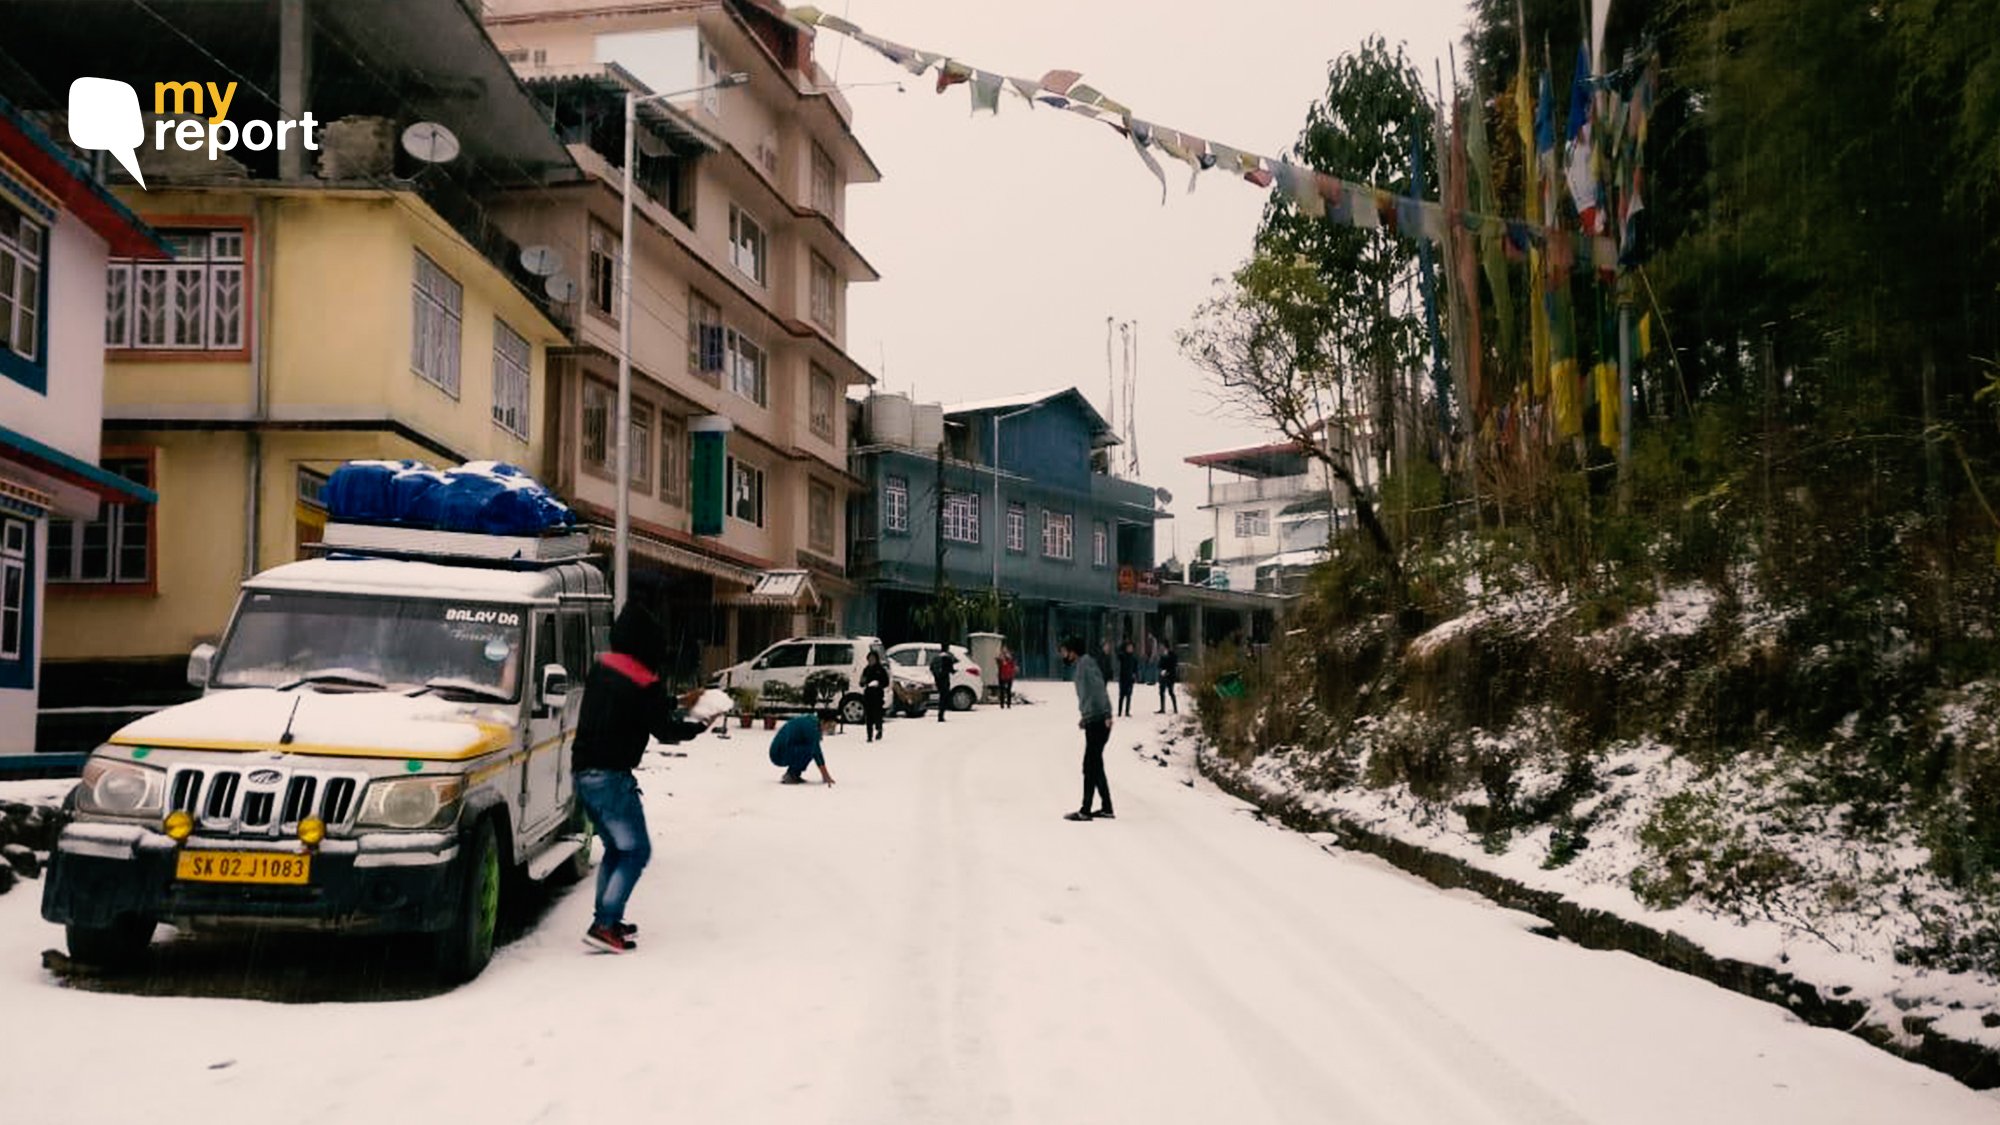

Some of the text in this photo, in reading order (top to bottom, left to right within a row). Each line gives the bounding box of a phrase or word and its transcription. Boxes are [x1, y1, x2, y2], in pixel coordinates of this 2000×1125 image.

[446, 608, 519, 626] BALAY DA
[192, 856, 215, 876] SK
[219, 858, 242, 877] 02
